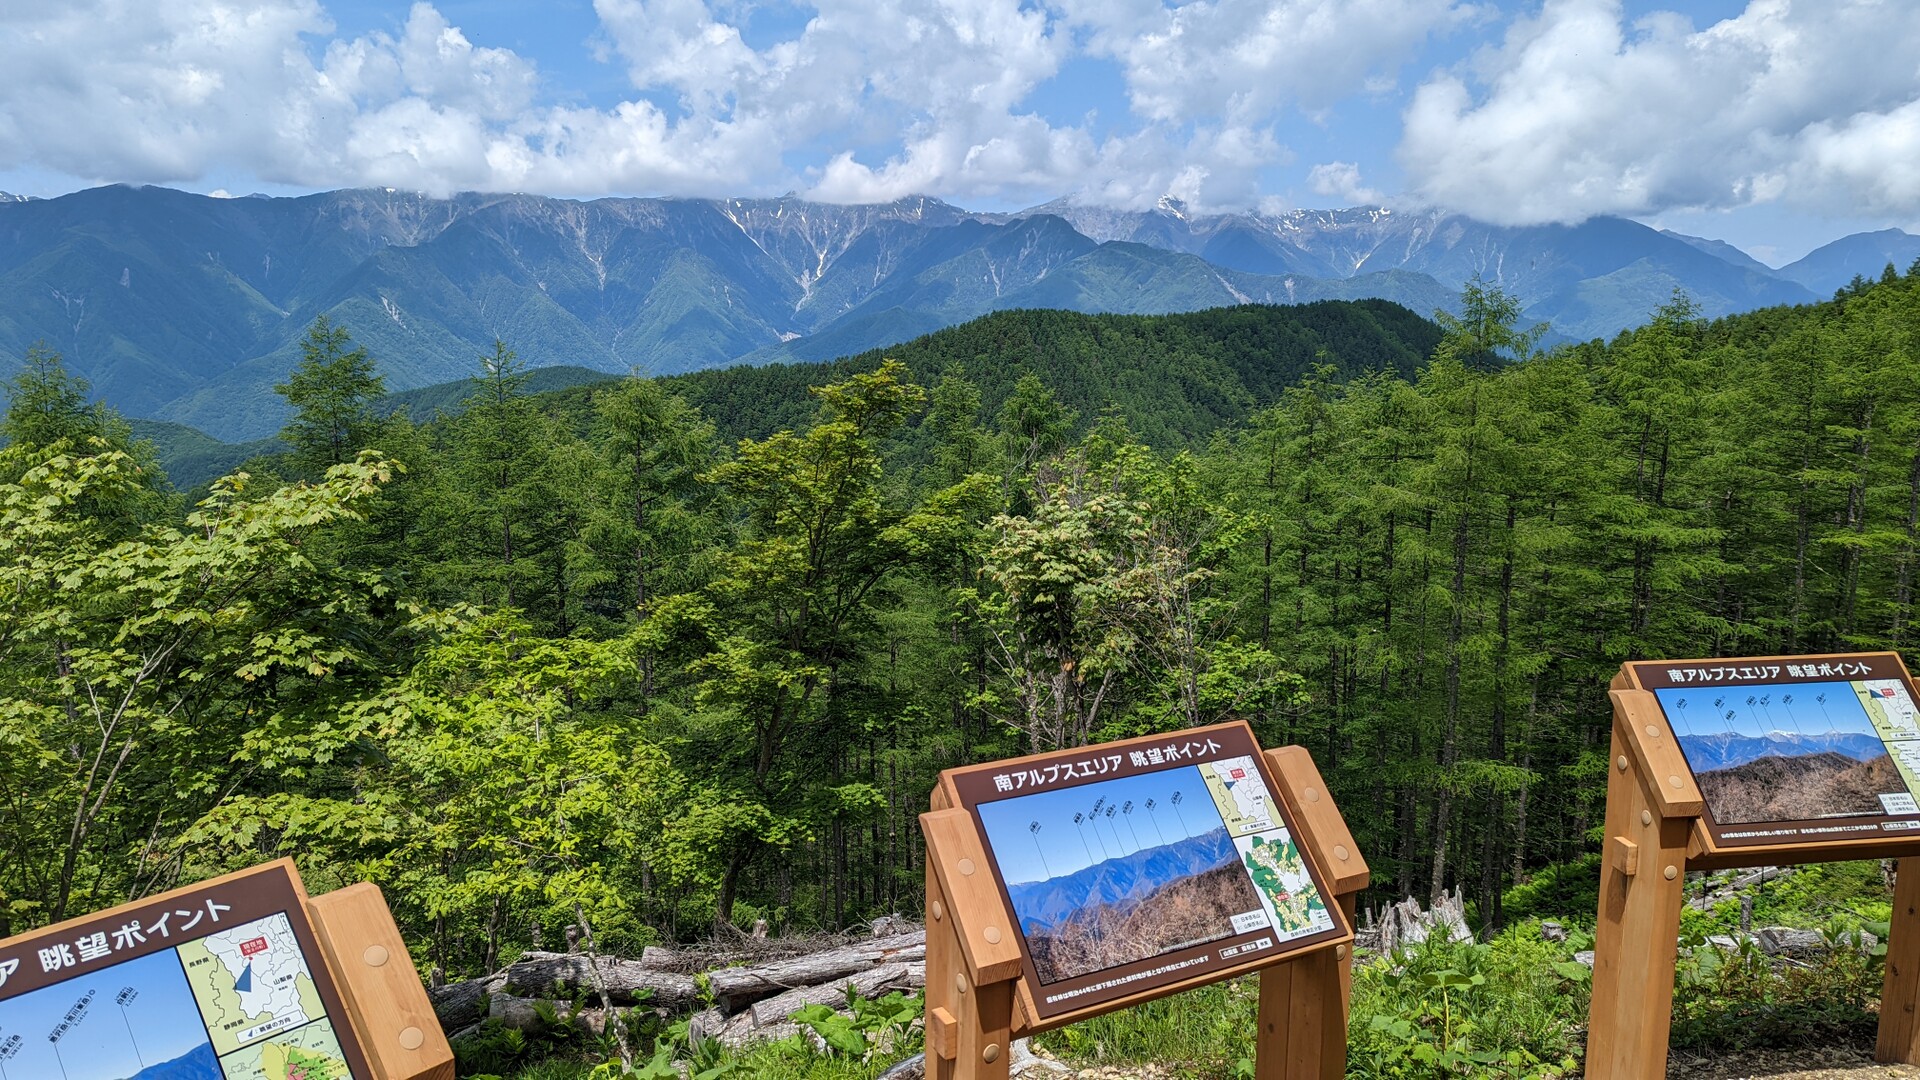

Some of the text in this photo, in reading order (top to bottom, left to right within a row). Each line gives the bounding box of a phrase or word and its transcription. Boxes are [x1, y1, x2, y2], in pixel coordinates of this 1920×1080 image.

[1667, 661, 1873, 683] 南アルプスエリア 眺望ポイント
[993, 738, 1222, 793] 南アルプスエリア 眺望ポイント
[37, 899, 231, 973] 眺望ポイント
[189, 956, 210, 968] 長野県
[273, 974, 293, 985] 山梨県
[223, 1018, 245, 1031] 静岡県
[260, 1016, 292, 1033] 眺望の方向
